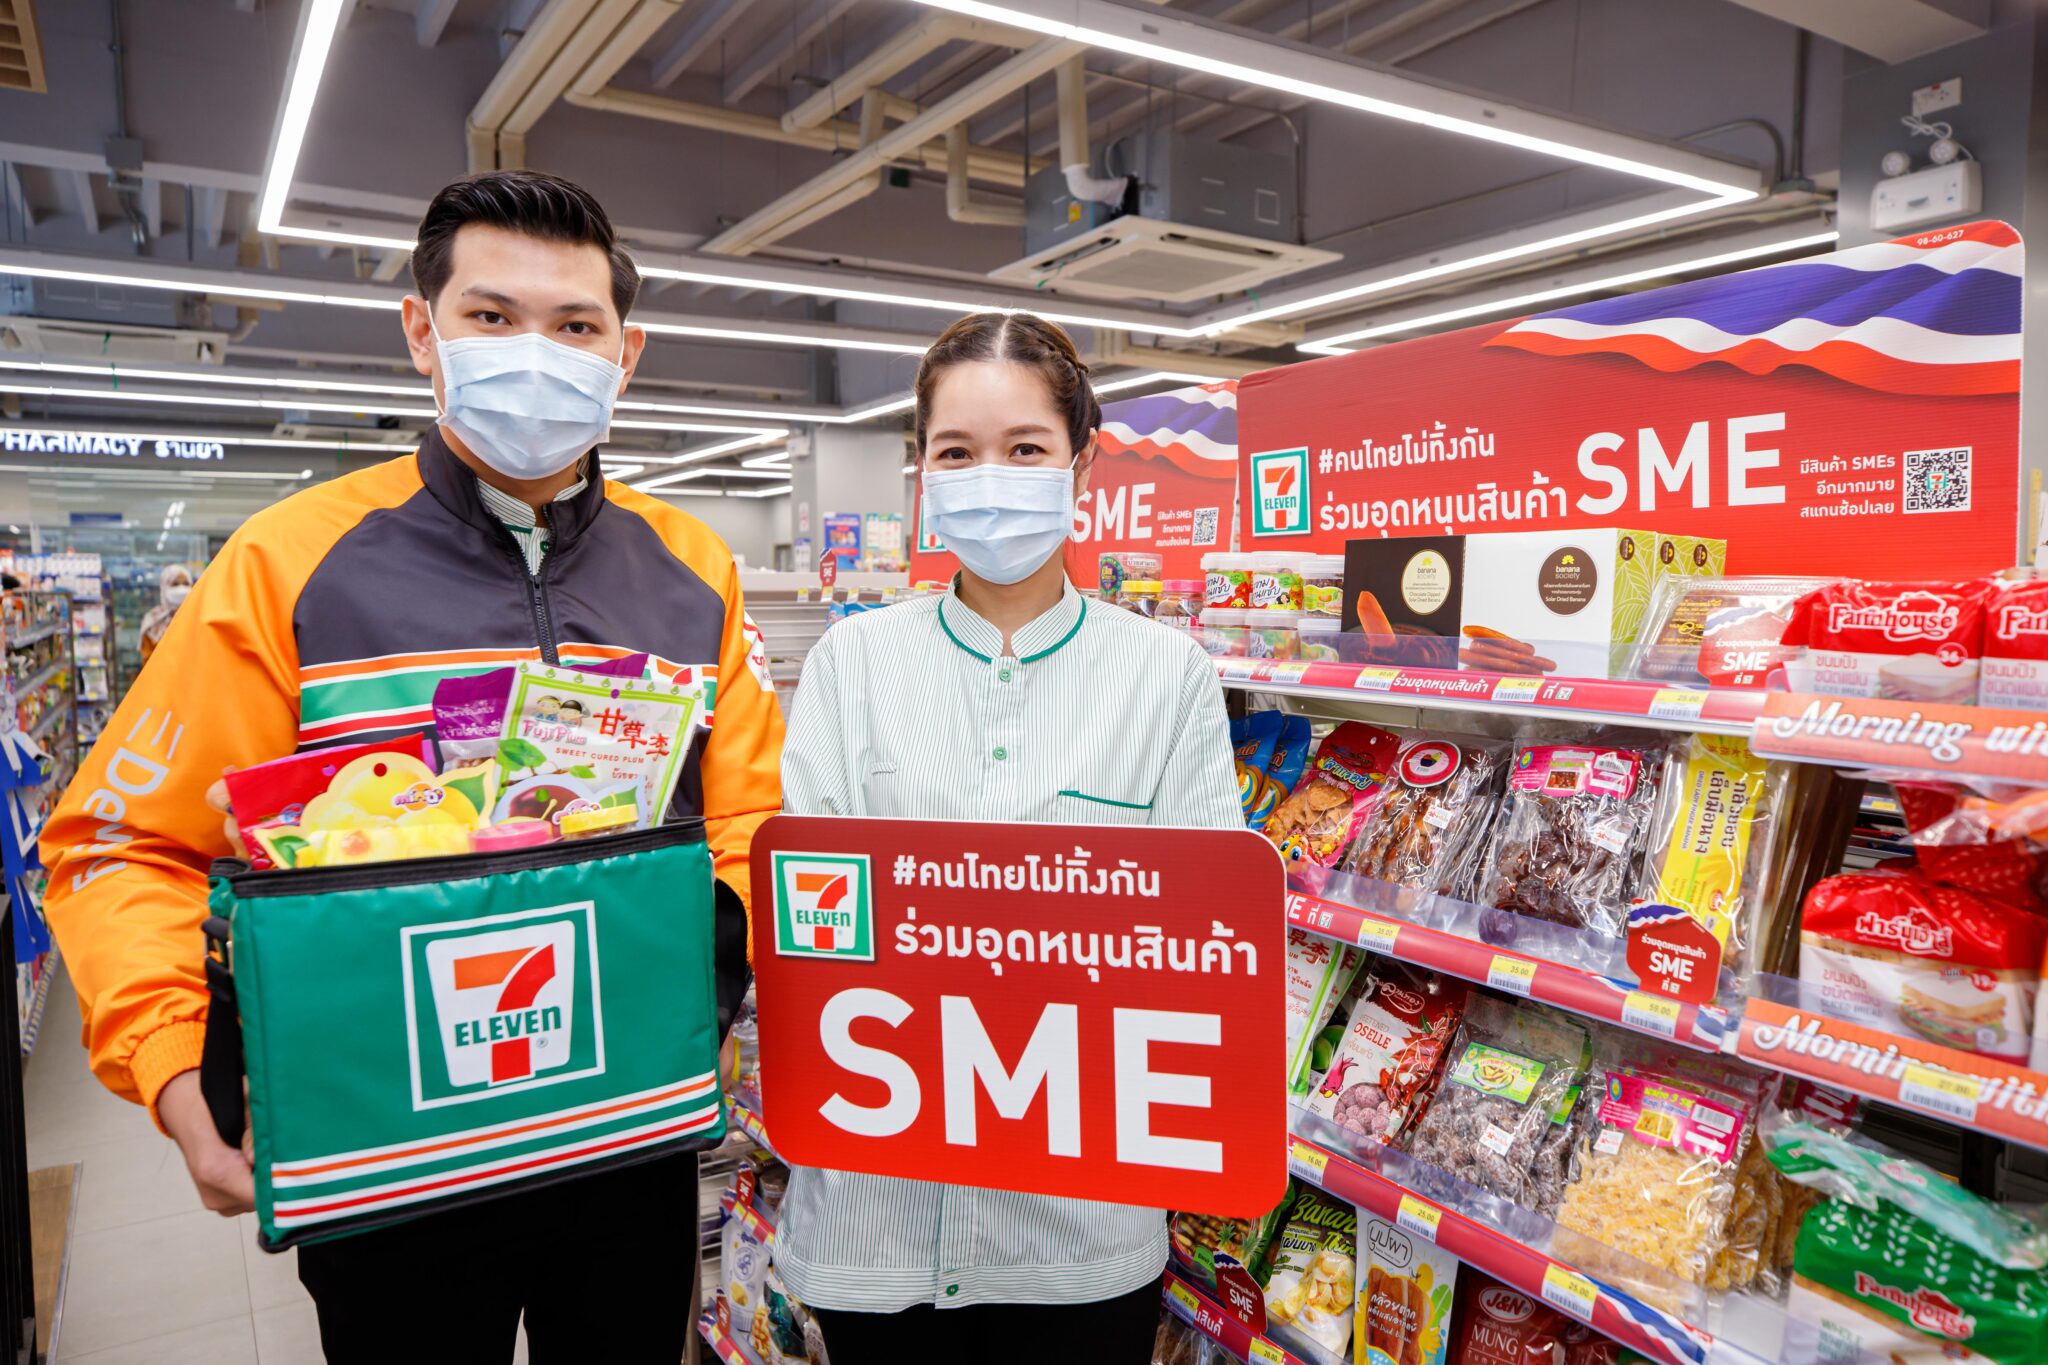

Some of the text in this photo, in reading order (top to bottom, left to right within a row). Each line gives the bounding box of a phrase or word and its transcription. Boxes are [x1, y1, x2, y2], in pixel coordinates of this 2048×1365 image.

[1917, 230, 1964, 246] 98-60-627
[1318, 421, 1495, 474] #คนไทยไม่ทิ้งกัน
[1576, 412, 1786, 515] SME
[1800, 455, 1896, 475] มีสินค้า SMEs
[1816, 477, 1896, 495] อีกมากมาย
[1070, 482, 1156, 543] SME
[1319, 471, 1568, 538] ร่วมอุดหนุนสินค้า
[1800, 499, 1896, 519] สแกนช้อปเลย
[1555, 565, 1581, 573] banana
[1555, 572, 1580, 580] society
[1829, 601, 1959, 638] Farmhouse
[1721, 651, 1770, 671] SME
[1393, 673, 1489, 697] ร่วมอุดหนุนสินค้า
[1543, 682, 1558, 698] ที่
[523, 719, 555, 743] Fuji
[1772, 699, 1973, 763] Morning
[556, 747, 645, 764] SWEET CURED PLUM
[1695, 770, 1729, 853] เล็บมือนาง
[893, 847, 1160, 897] #คนไทยไม่ทิ้งกัน
[894, 907, 1258, 983] ร่วมอุดหนุนสินค้า
[1641, 934, 1707, 960] ร่วมอุดหนุนสินค้า
[1648, 951, 1695, 982] SME
[1753, 1014, 1948, 1079] Morni
[818, 987, 1224, 1174] SME
[1307, 1155, 1323, 1167] 16.00
[1290, 1193, 1357, 1236] Banan
[1417, 1208, 1436, 1222] 25.00
[1229, 1288, 1254, 1316] SME
[1567, 1281, 1591, 1298] 25.00
[1371, 1291, 1416, 1319] กล้วยตาก
[1486, 1292, 1524, 1316] J&N
[1856, 1272, 1974, 1339] Farmhouse
[1472, 1324, 1518, 1355] MUNG
[1264, 1350, 1278, 1362] 20.00
